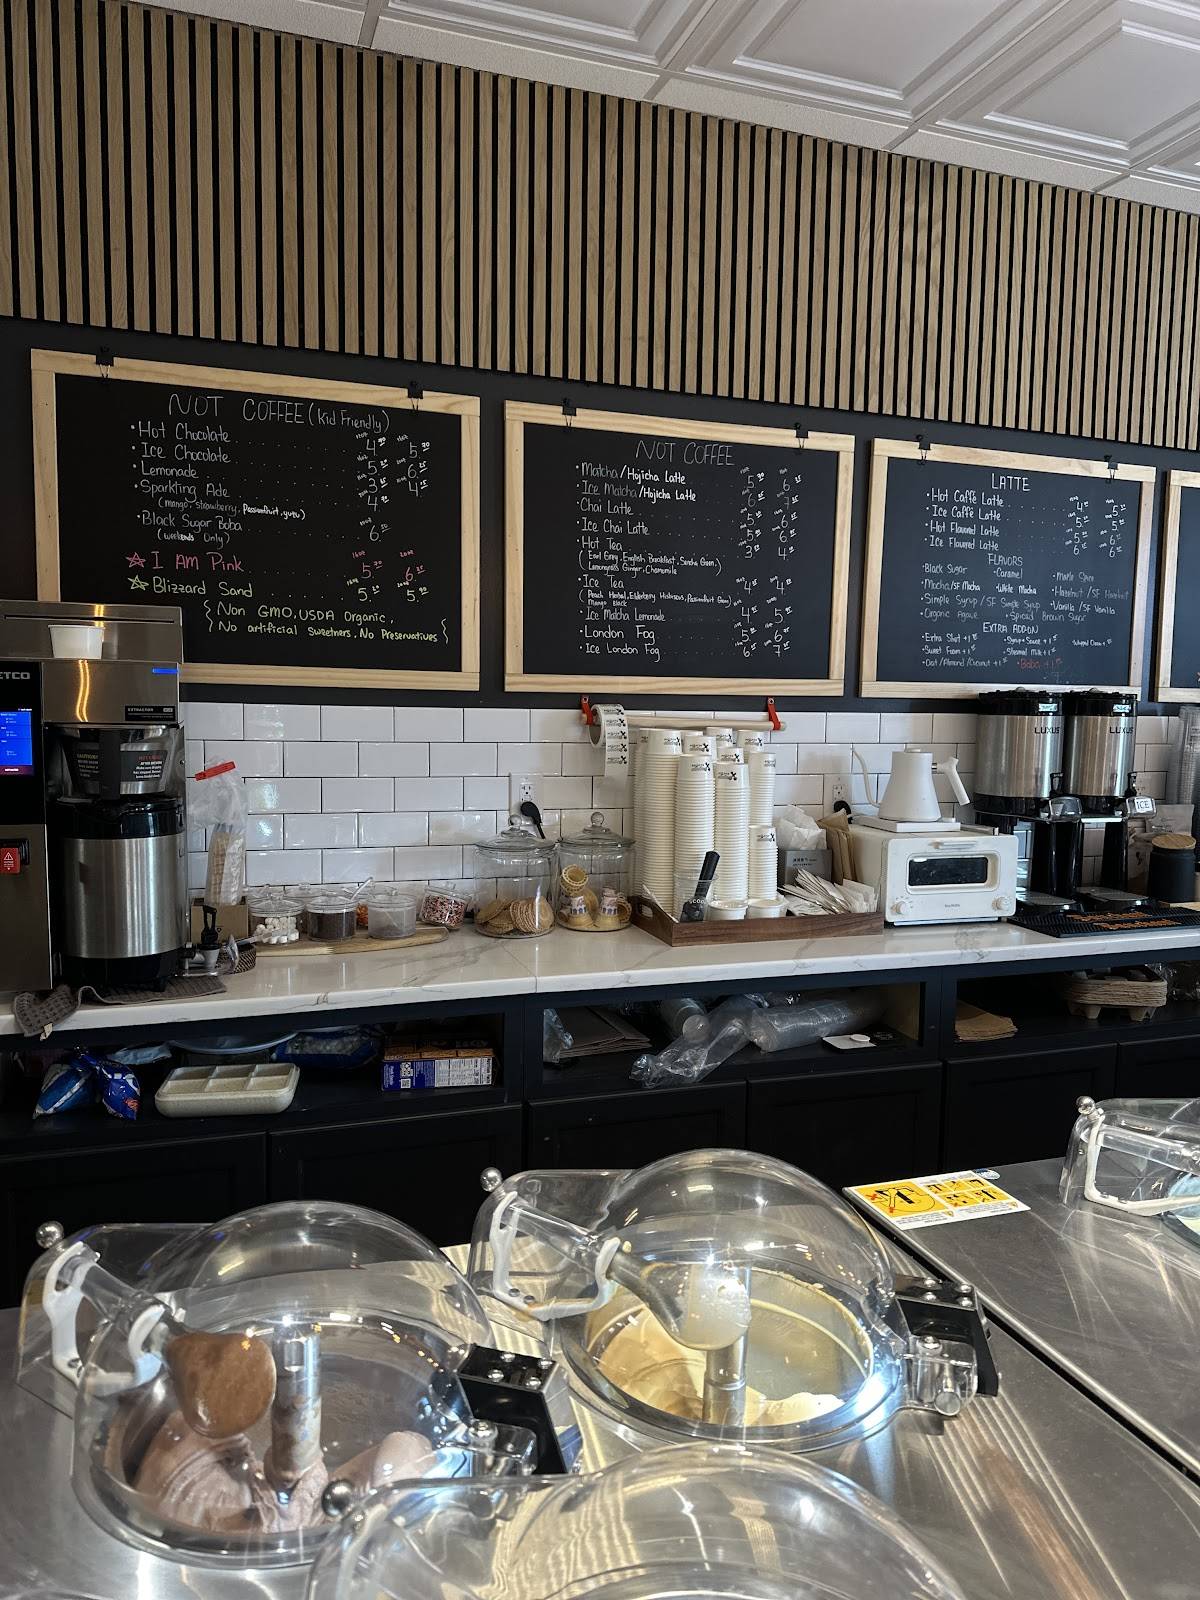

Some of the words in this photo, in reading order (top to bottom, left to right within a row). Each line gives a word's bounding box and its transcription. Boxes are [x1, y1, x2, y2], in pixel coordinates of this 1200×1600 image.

[168, 393, 224, 417] NOT
[243, 398, 305, 424] COFFEE
[138, 421, 166, 438] Hot
[175, 422, 231, 443] Chocolate
[141, 442, 166, 458] Ice
[174, 444, 231, 464] Chocolate
[636, 440, 676, 462] NOT
[684, 441, 735, 466] COFFEE
[141, 460, 199, 479] Lemonade
[665, 470, 686, 485] Latte
[991, 473, 1031, 491] LATTE
[140, 479, 197, 503] Sparkling
[206, 482, 230, 498] Ade
[582, 480, 600, 495] Ice
[675, 489, 696, 501] Latte
[931, 488, 948, 502] Hot
[981, 492, 1004, 507] Latte
[580, 497, 602, 512] Chai
[608, 500, 634, 516] Latte
[932, 505, 947, 517] Ice
[979, 508, 1001, 521] Latte
[142, 510, 175, 527] Black
[182, 513, 211, 533] Sugar
[215, 516, 242, 531] Boba
[582, 517, 599, 532] Ice
[603, 519, 623, 534] Chai
[627, 520, 650, 536] Latte
[930, 520, 945, 532] Hot
[980, 525, 1000, 537] Latte
[582, 536, 600, 549] Hot
[606, 537, 622, 551] Tea
[929, 535, 944, 547] Ice
[979, 540, 999, 551] Latte
[151, 551, 164, 569] I
[206, 552, 244, 572] Pink
[988, 553, 1023, 566] FLAVORS
[924, 563, 943, 573] Black
[947, 564, 968, 575] Sugar
[996, 567, 1023, 579] Caramel
[152, 576, 206, 595] Blizzard
[218, 582, 253, 598] Sand
[583, 574, 600, 587] Ice
[607, 575, 624, 588] Tea
[962, 581, 981, 591] Mocha
[998, 584, 1013, 593] White
[1019, 585, 1037, 595] Mocha
[217, 601, 246, 616] Non
[924, 593, 950, 605] Simple
[956, 595, 978, 608] Syrup
[1024, 600, 1040, 612] Syrup
[1052, 600, 1075, 611] Vanilla
[1094, 605, 1115, 615] Vanilla
[585, 607, 600, 621] Ice
[604, 607, 630, 621] Matcha
[634, 607, 666, 622] Lemonade
[924, 608, 950, 621] Organic
[1042, 611, 1064, 622] Brown
[1068, 612, 1087, 624] Sugar
[219, 621, 237, 632] No
[247, 623, 298, 635] artificial
[359, 628, 374, 639] No
[381, 629, 438, 642] Preservatives
[584, 625, 624, 639] London
[636, 625, 655, 645] Fog
[983, 622, 1008, 633] EXTRA
[925, 633, 942, 642] Extra
[946, 633, 960, 642] Shot
[586, 643, 600, 654] Ice
[607, 643, 638, 654] London
[645, 643, 661, 663] Fog
[925, 645, 941, 654] Sweet
[0, 672, 30, 680] TCO
[1136, 801, 1150, 809] ICE
